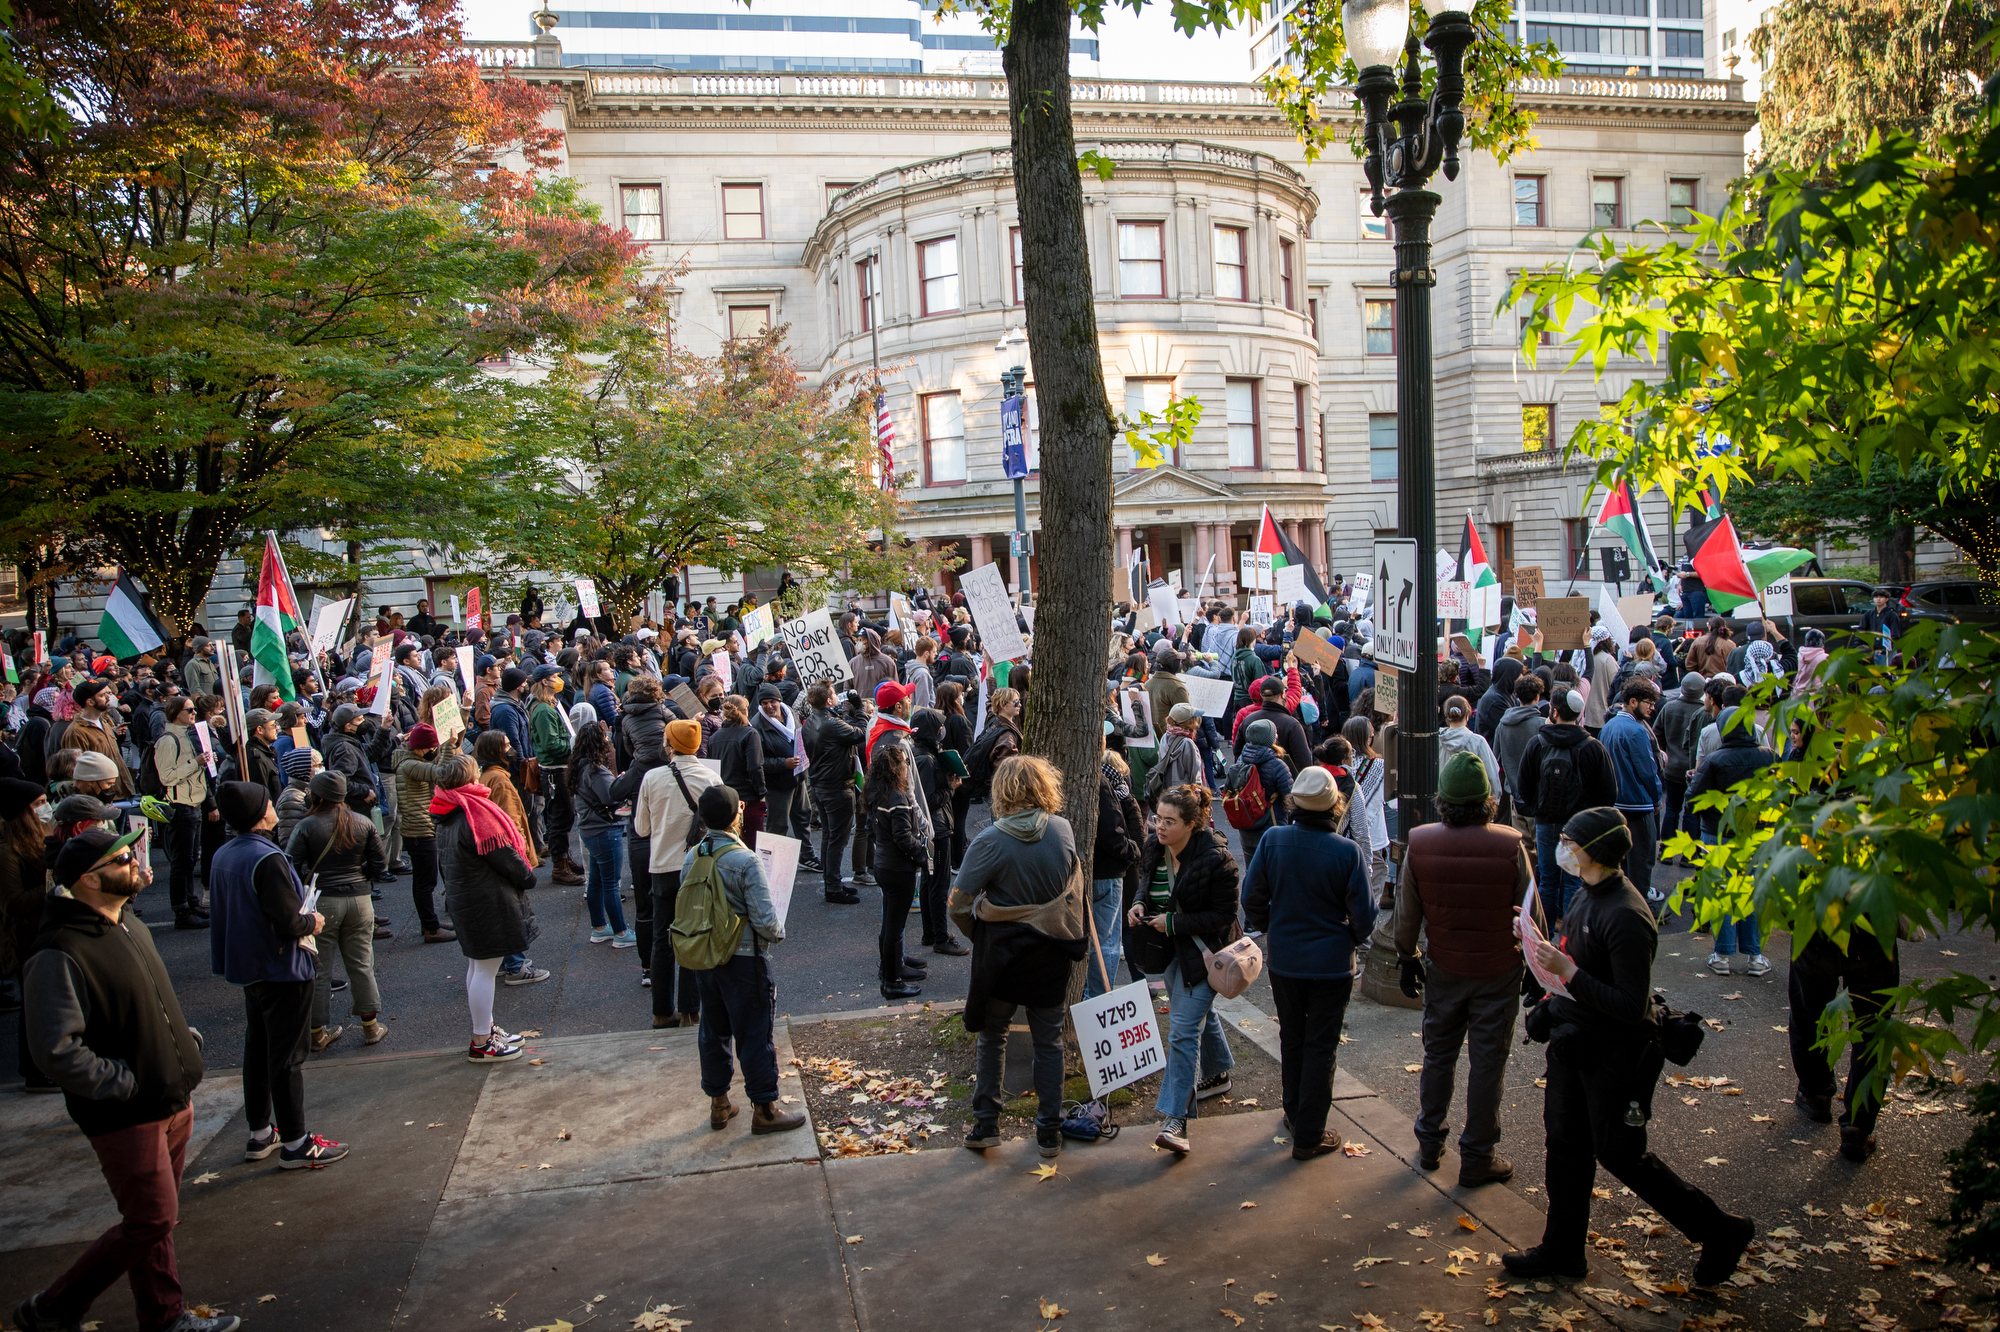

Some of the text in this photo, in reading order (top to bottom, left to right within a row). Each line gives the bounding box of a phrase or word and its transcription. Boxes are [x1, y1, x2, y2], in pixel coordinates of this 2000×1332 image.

[1004, 428, 1022, 448] PERA
[1258, 560, 1270, 569] BDS
[1436, 562, 1457, 582] alestine
[1514, 569, 1538, 578] WITHOUT
[965, 580, 982, 599] NO
[1441, 591, 1456, 599] FREE
[1766, 584, 1788, 595] BDS
[977, 597, 993, 615] AID
[1438, 599, 1459, 608] PALESTINE
[1542, 602, 1586, 612] GENOCIDE
[782, 620, 806, 641] NO
[1546, 616, 1580, 627] NEVER
[752, 624, 774, 646] NOW
[788, 626, 830, 656] MONEY
[1376, 634, 1392, 655] ONLY
[376, 642, 390, 655] FREE
[1397, 639, 1414, 660] ONLY
[796, 652, 829, 676] FOR
[1382, 674, 1395, 688] END
[1377, 684, 1398, 698] OCCUP
[435, 707, 458, 728] OCCUPATION
[1096, 1000, 1137, 1029] GAZA
[1094, 1022, 1151, 1060] SIEGE OF
[1099, 1046, 1158, 1086] LIFT THE
[306, 1144, 326, 1158] N
